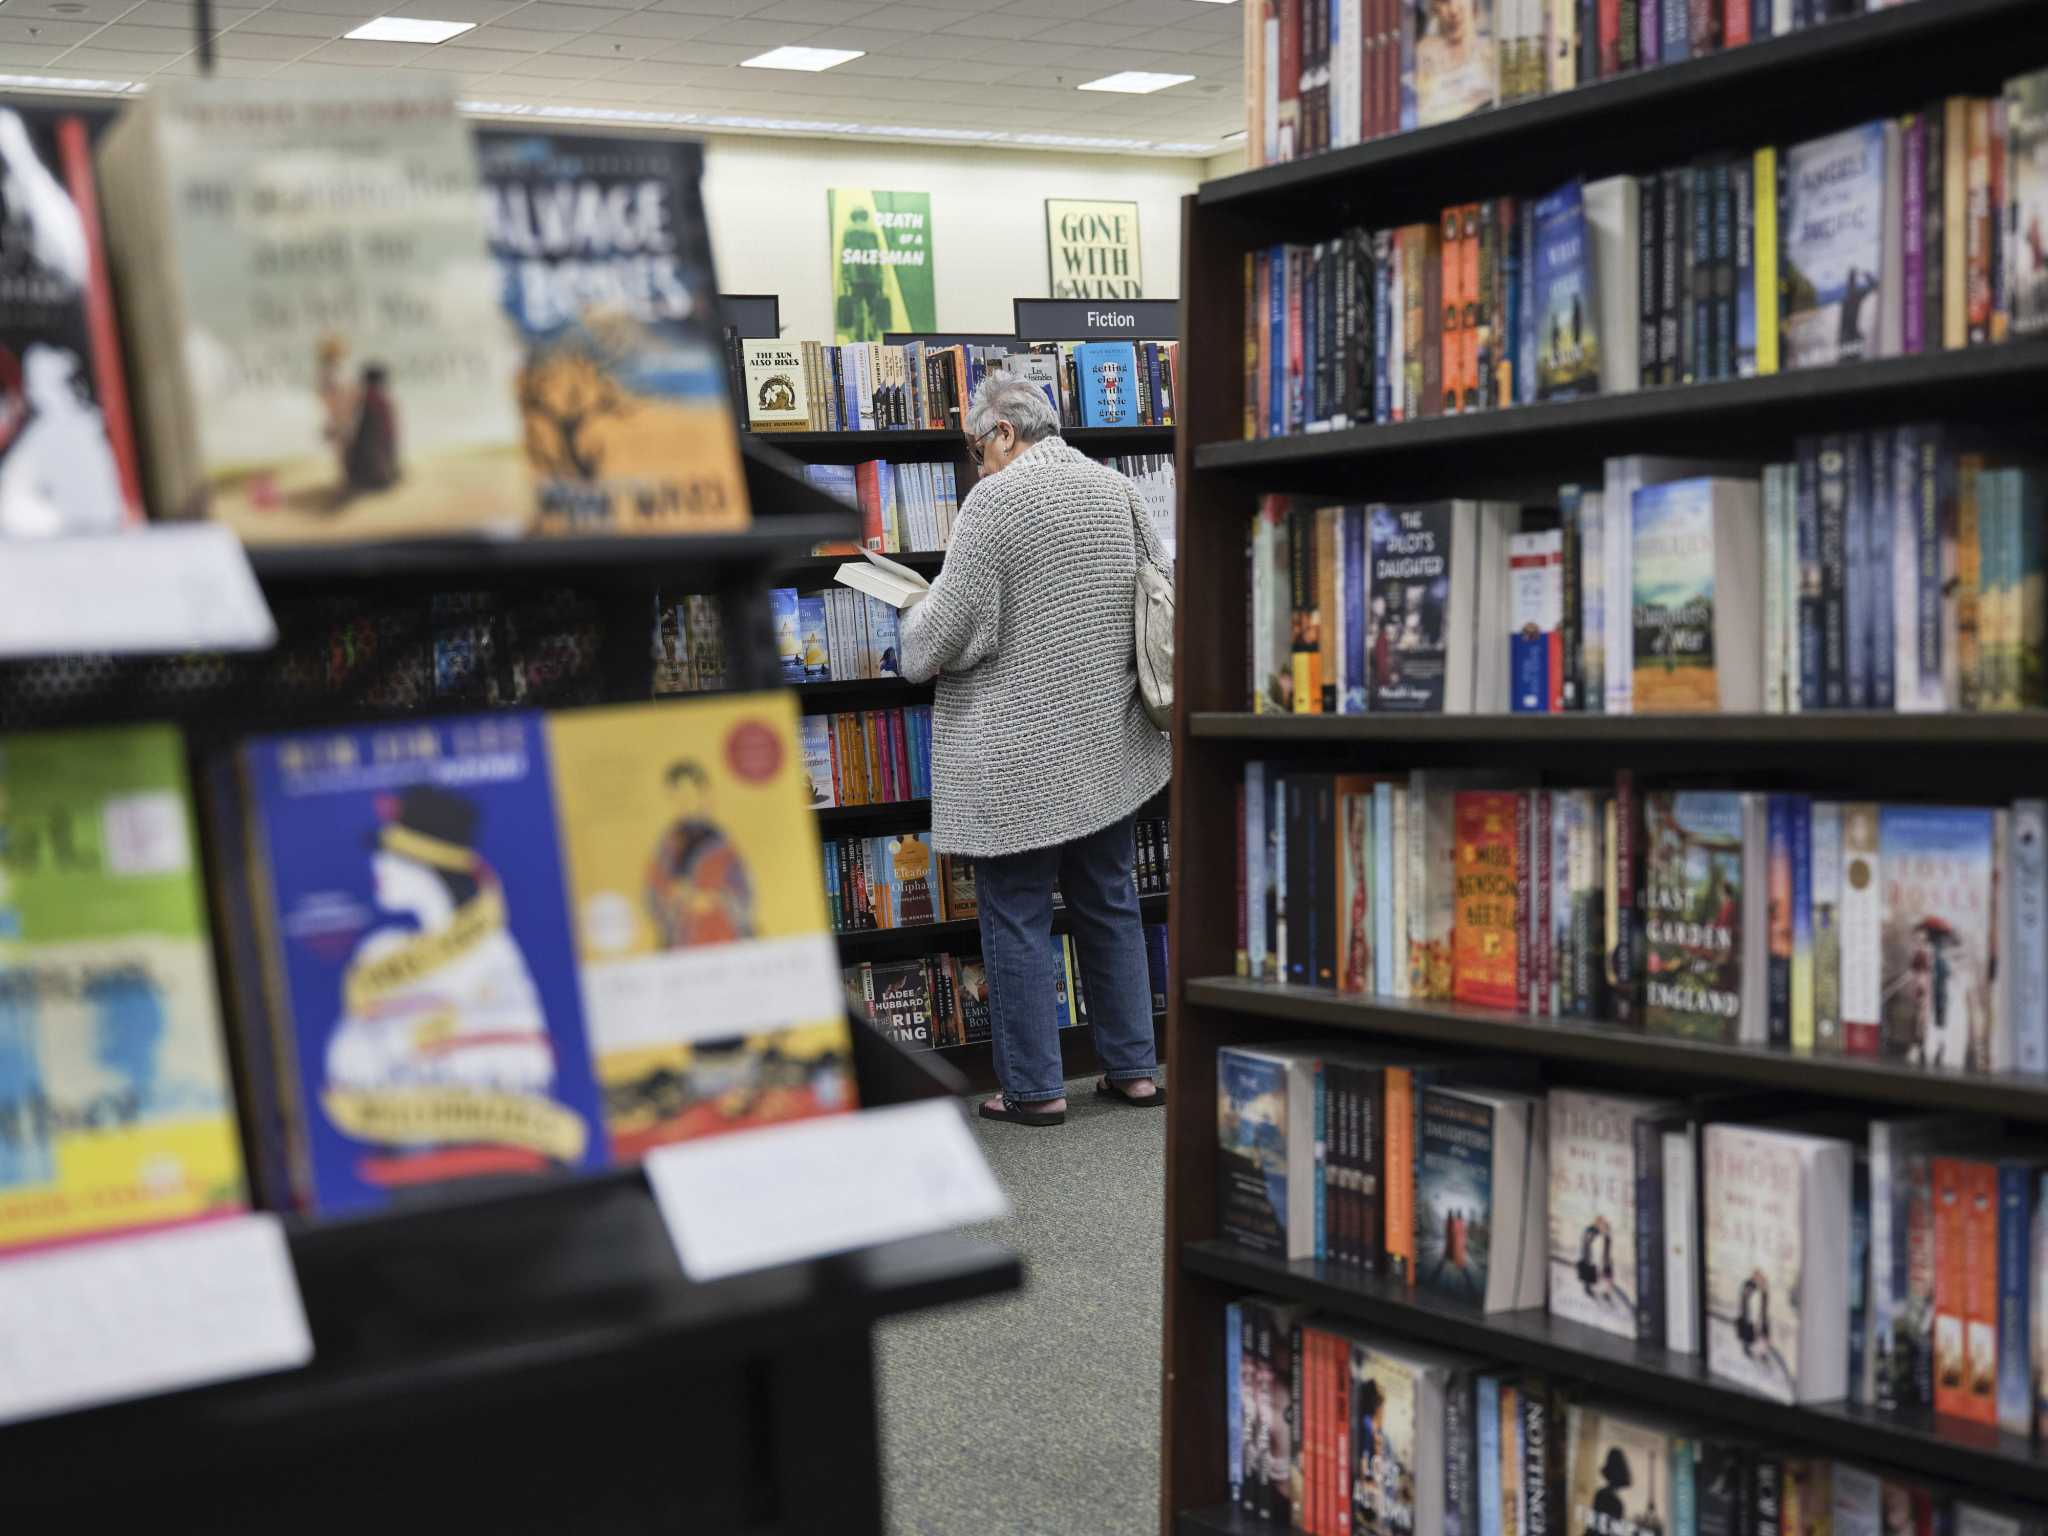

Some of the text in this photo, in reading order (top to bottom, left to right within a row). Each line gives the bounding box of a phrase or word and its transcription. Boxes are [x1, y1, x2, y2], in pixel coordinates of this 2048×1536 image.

[875, 212, 924, 228] DEATH
[1061, 213, 1128, 245] GONE
[843, 249, 925, 266] SALESMAN
[1061, 246, 1129, 276] WITH
[1087, 311, 1135, 327] Fiction
[1092, 363, 1128, 373] getting
[890, 880, 939, 894] Oliphant
[1646, 918, 1732, 948] GARDEN
[882, 989, 915, 1000] LADEE
[1647, 981, 1740, 1018] ENGLAND
[875, 999, 924, 1010] HUBBARD
[892, 1012, 926, 1027] RIB
